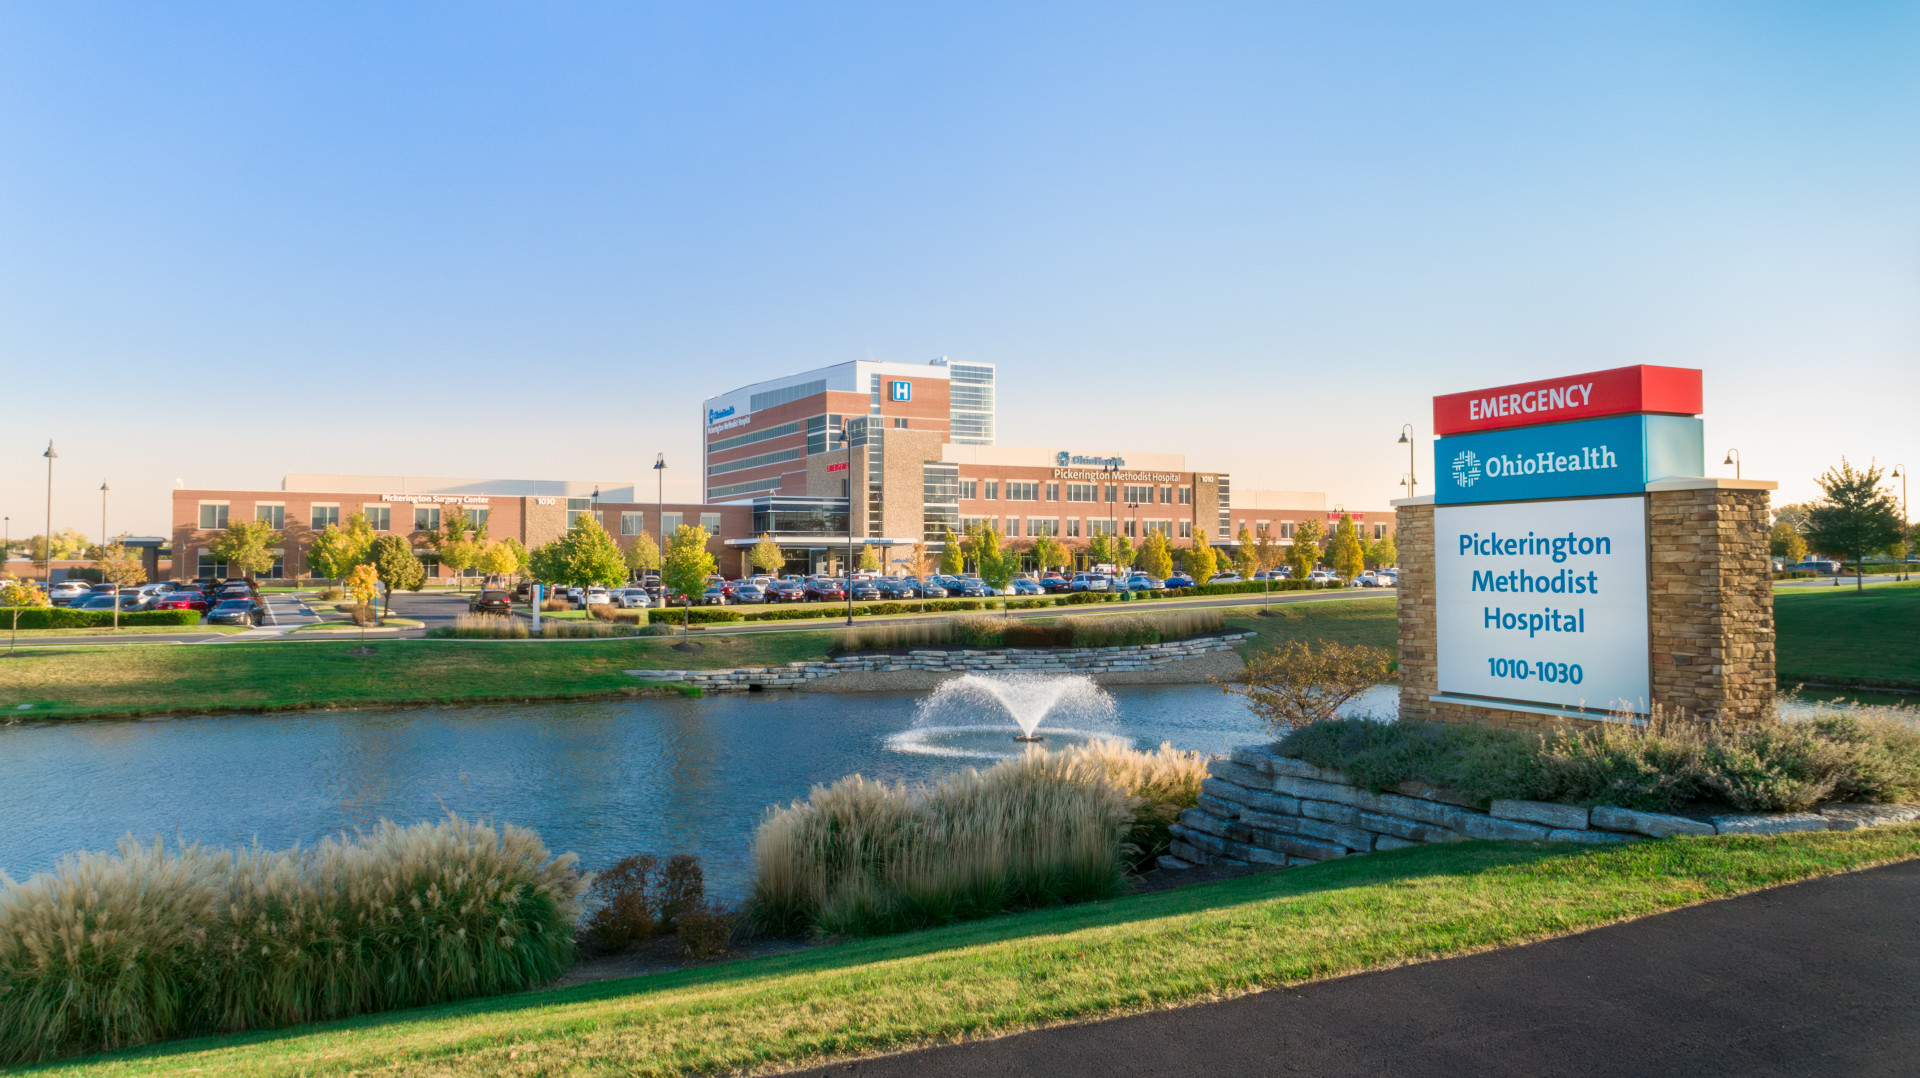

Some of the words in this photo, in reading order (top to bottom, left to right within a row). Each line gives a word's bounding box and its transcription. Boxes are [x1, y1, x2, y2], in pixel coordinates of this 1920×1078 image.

[896, 382, 909, 400] H
[1469, 382, 1593, 421] EMERGENCY
[1485, 445, 1618, 478] OhioHealth
[1054, 468, 1110, 483] Pickerington
[1111, 471, 1152, 482] Methodist
[1152, 472, 1181, 485] Hospital
[1201, 475, 1214, 483] 1010
[381, 494, 432, 504] Pickerington
[433, 495, 463, 505] Surgery
[464, 496, 489, 504] Center
[537, 498, 556, 506] 1030
[1459, 531, 1612, 564] Pickerington
[1471, 568, 1599, 595] Methodist
[1484, 606, 1585, 639] Hospital
[1487, 657, 1584, 685] 1010-1030
